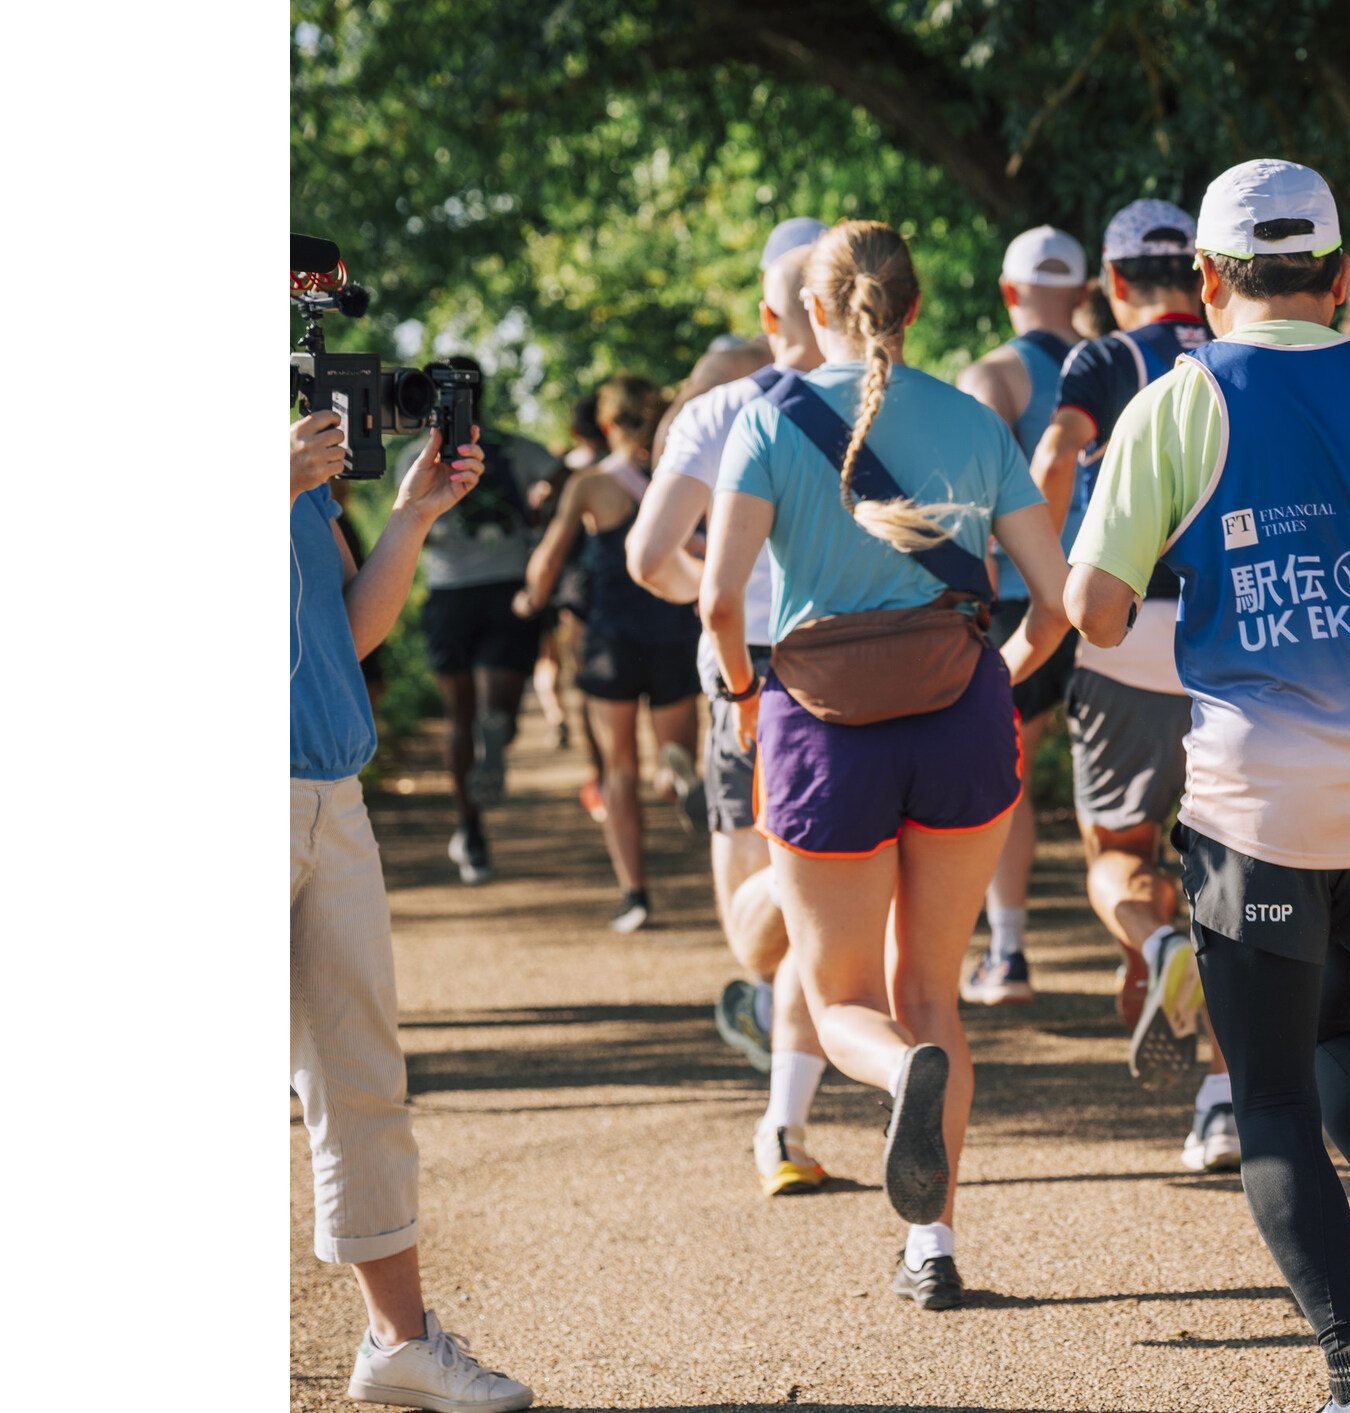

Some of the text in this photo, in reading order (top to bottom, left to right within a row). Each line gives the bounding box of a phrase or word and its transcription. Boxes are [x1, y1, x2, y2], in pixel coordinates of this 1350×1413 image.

[1225, 503, 1251, 535] FT
[1259, 503, 1336, 523] FINANCIAL
[1262, 520, 1307, 537] TIMES
[1231, 554, 1328, 614] 駅伝
[1238, 610, 1299, 652] UK
[1245, 904, 1293, 922] STOP
